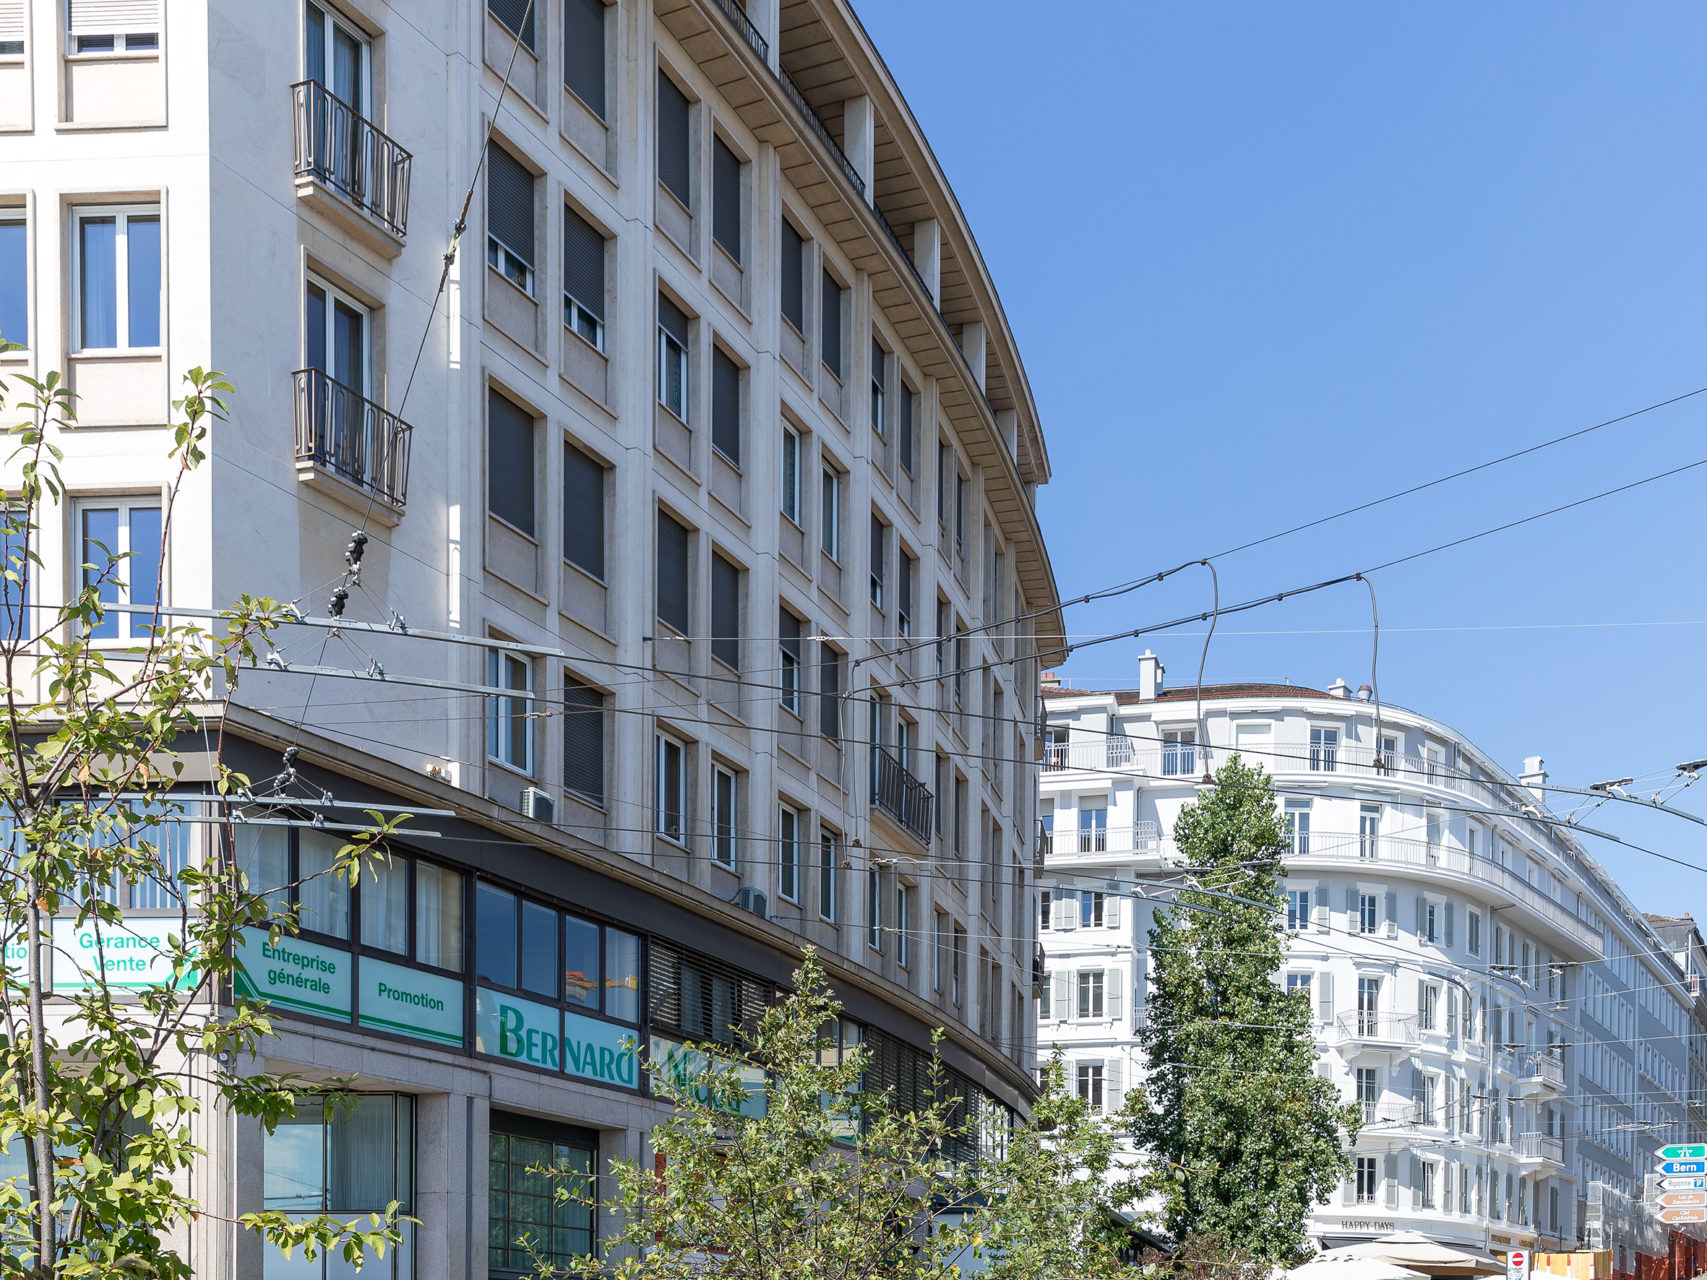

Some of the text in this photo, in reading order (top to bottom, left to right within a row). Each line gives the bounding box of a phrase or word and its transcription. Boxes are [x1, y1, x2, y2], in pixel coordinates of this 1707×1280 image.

[79, 932, 160, 949] Gérance
[93, 955, 146, 972] Vente
[262, 943, 337, 975] Entreprise
[267, 971, 331, 995] générale
[378, 982, 444, 1012] Promotion
[1673, 1163, 1697, 1172] Bern
[1341, 1220, 1395, 1231] HAPPY DAYS
